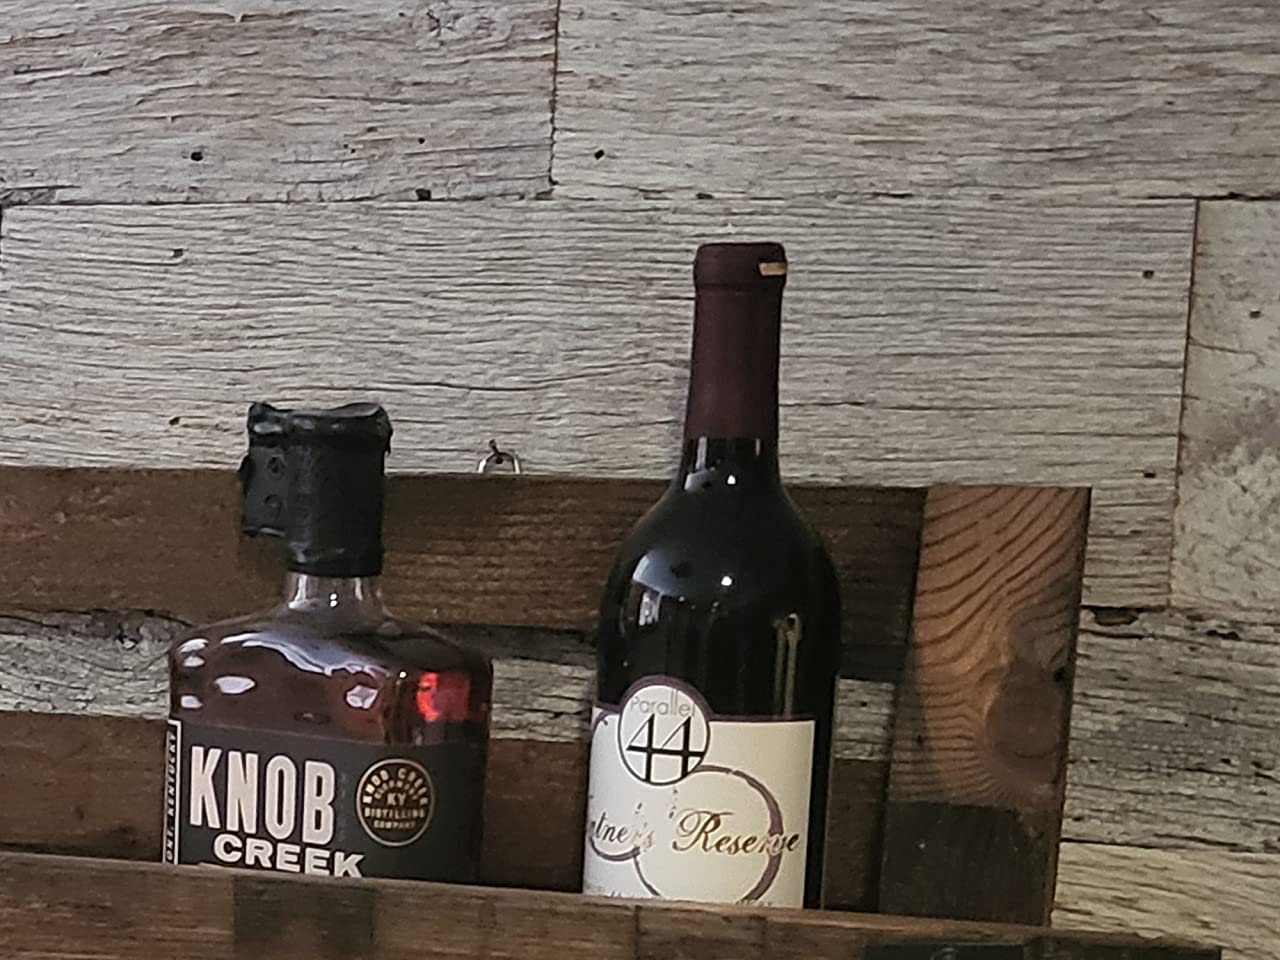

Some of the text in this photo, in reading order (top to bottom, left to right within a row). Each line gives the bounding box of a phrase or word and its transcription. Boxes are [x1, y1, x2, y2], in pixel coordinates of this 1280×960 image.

[630, 689, 697, 717] Parallel
[626, 713, 704, 783] 44
[167, 730, 176, 817] KENTUCKY
[190, 745, 336, 846] KNOB
[386, 792, 407, 806] KY
[672, 808, 800, 855] Reserve
[213, 833, 365, 878] CREEK
